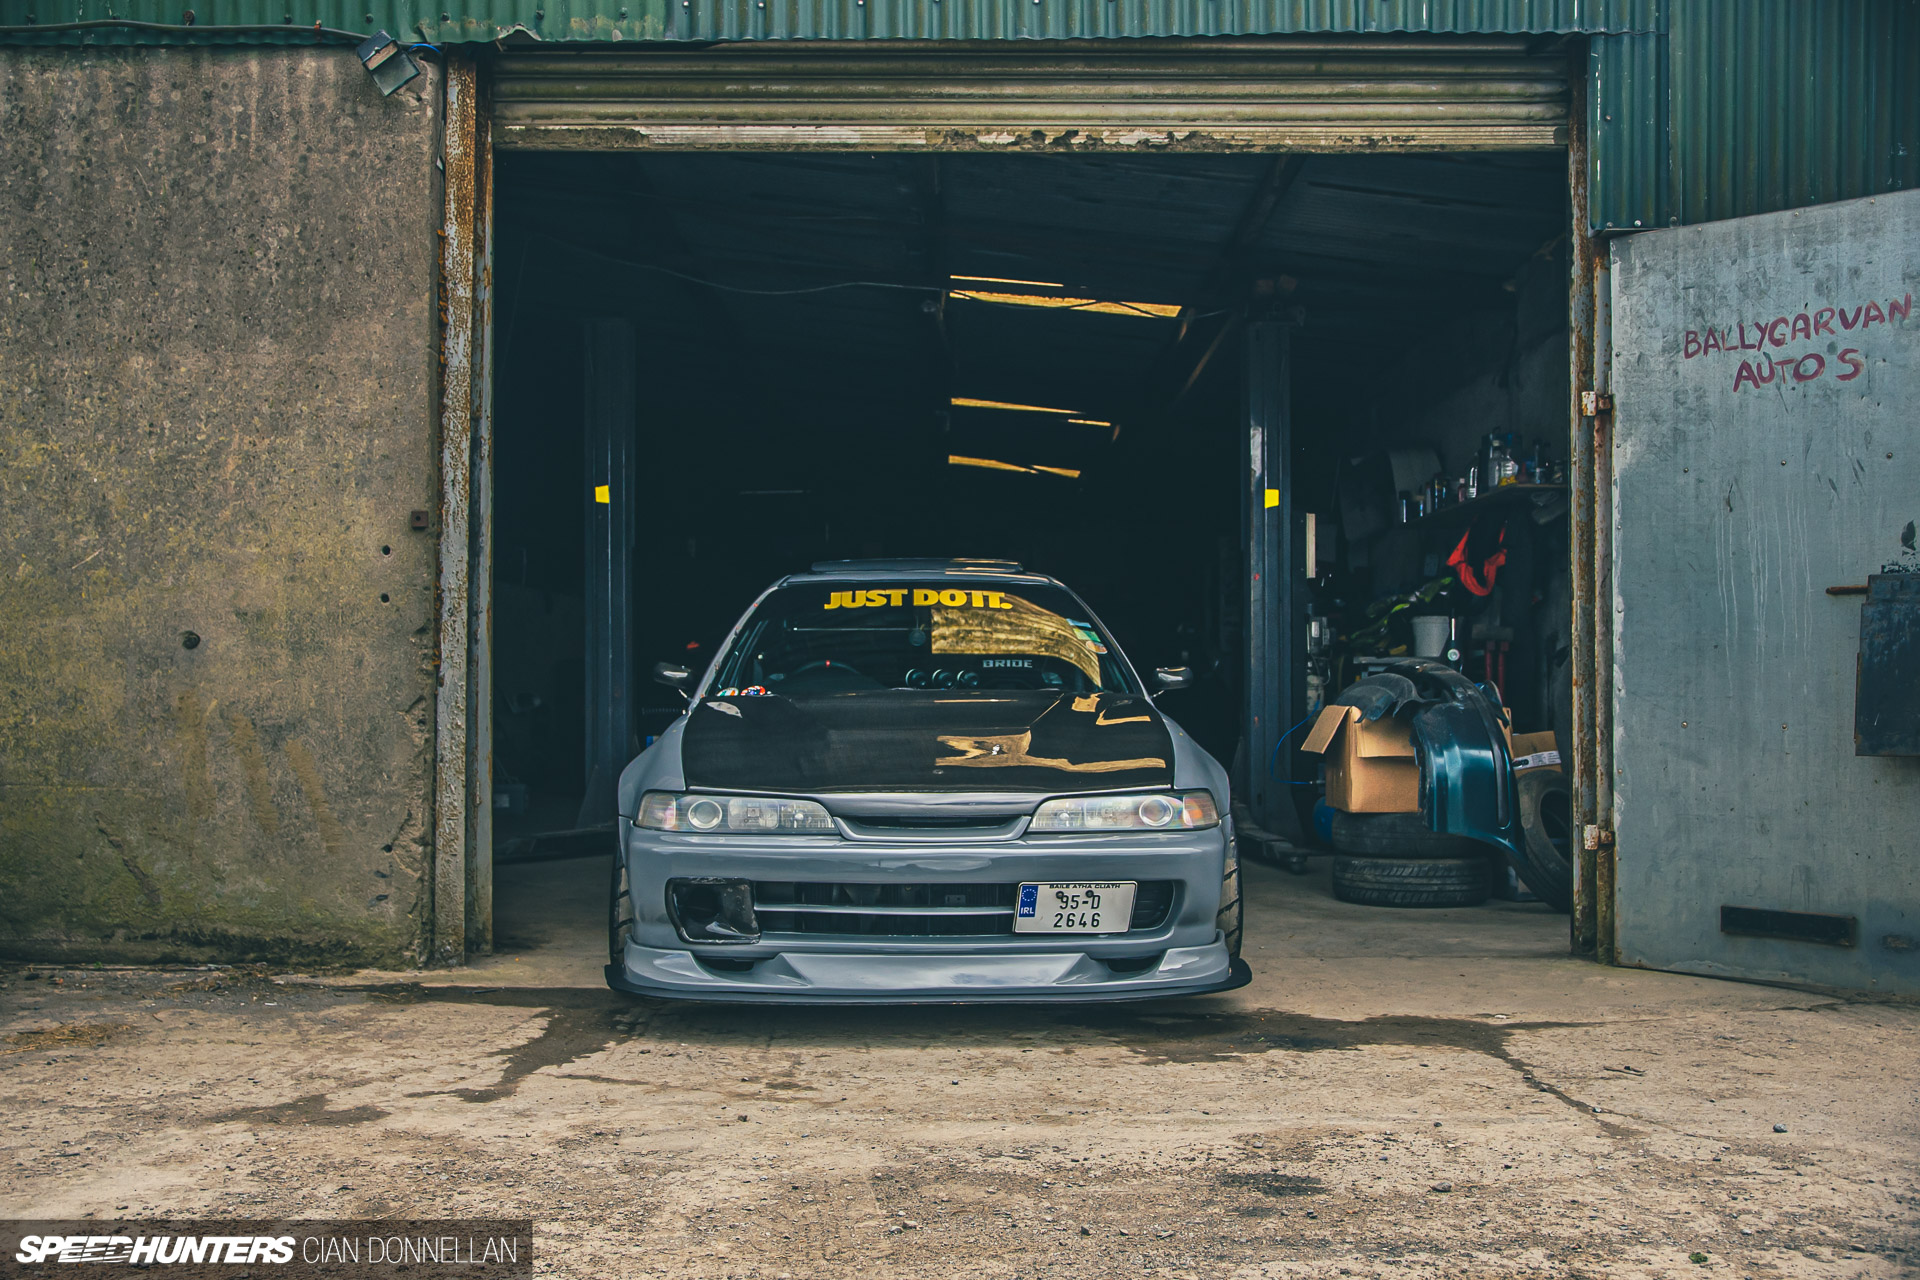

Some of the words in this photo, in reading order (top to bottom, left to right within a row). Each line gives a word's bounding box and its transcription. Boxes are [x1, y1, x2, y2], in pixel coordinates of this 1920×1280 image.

[1684, 292, 1912, 360] BALLYGARVAN
[1732, 348, 1865, 393] AUTOS
[824, 588, 908, 610] JUST
[913, 588, 967, 608] DO
[982, 659, 1033, 669] BRIDE
[1059, 894, 1101, 910] 95-D
[1020, 907, 1035, 915] IRL
[1053, 912, 1101, 928] 2646
